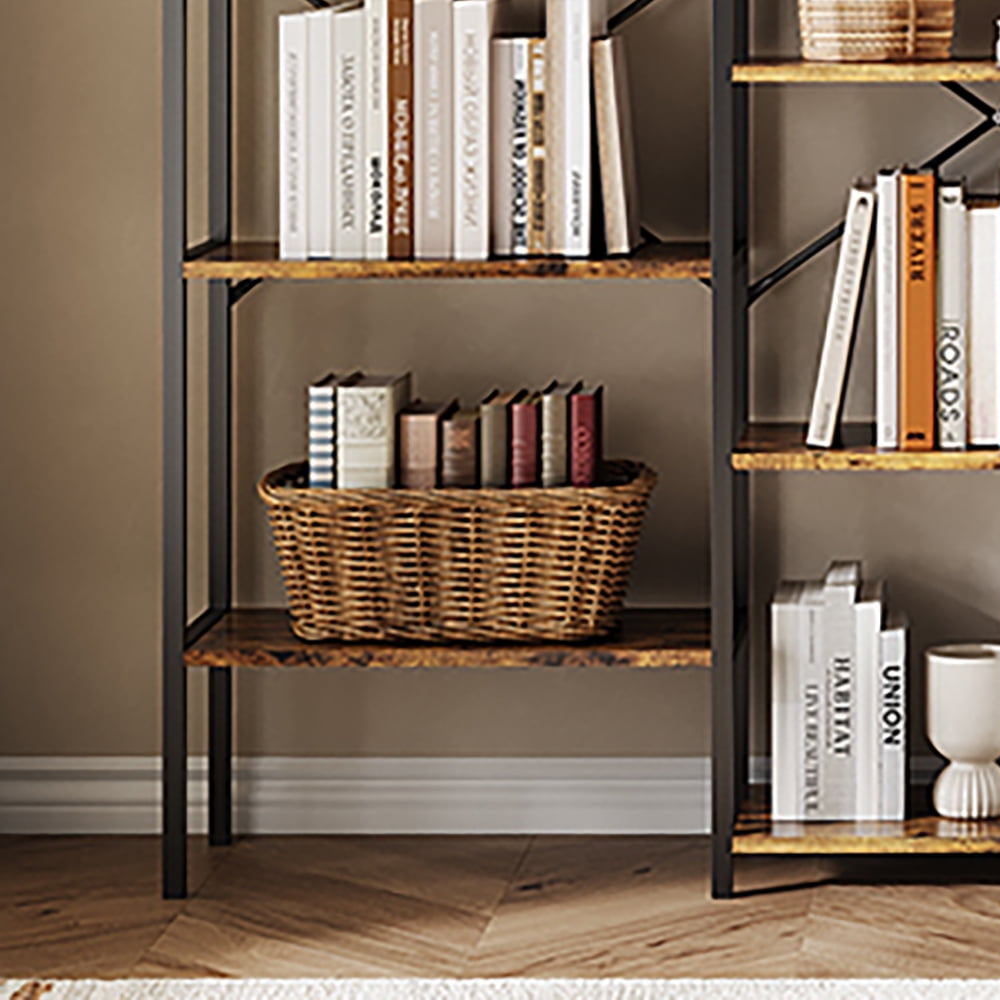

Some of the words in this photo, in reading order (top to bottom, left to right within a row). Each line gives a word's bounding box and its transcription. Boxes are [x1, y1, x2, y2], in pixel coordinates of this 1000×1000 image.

[910, 203, 926, 282] RIVERS
[938, 326, 961, 422] ROADS
[833, 657, 851, 755] HABITAT
[882, 665, 901, 746] UNION
